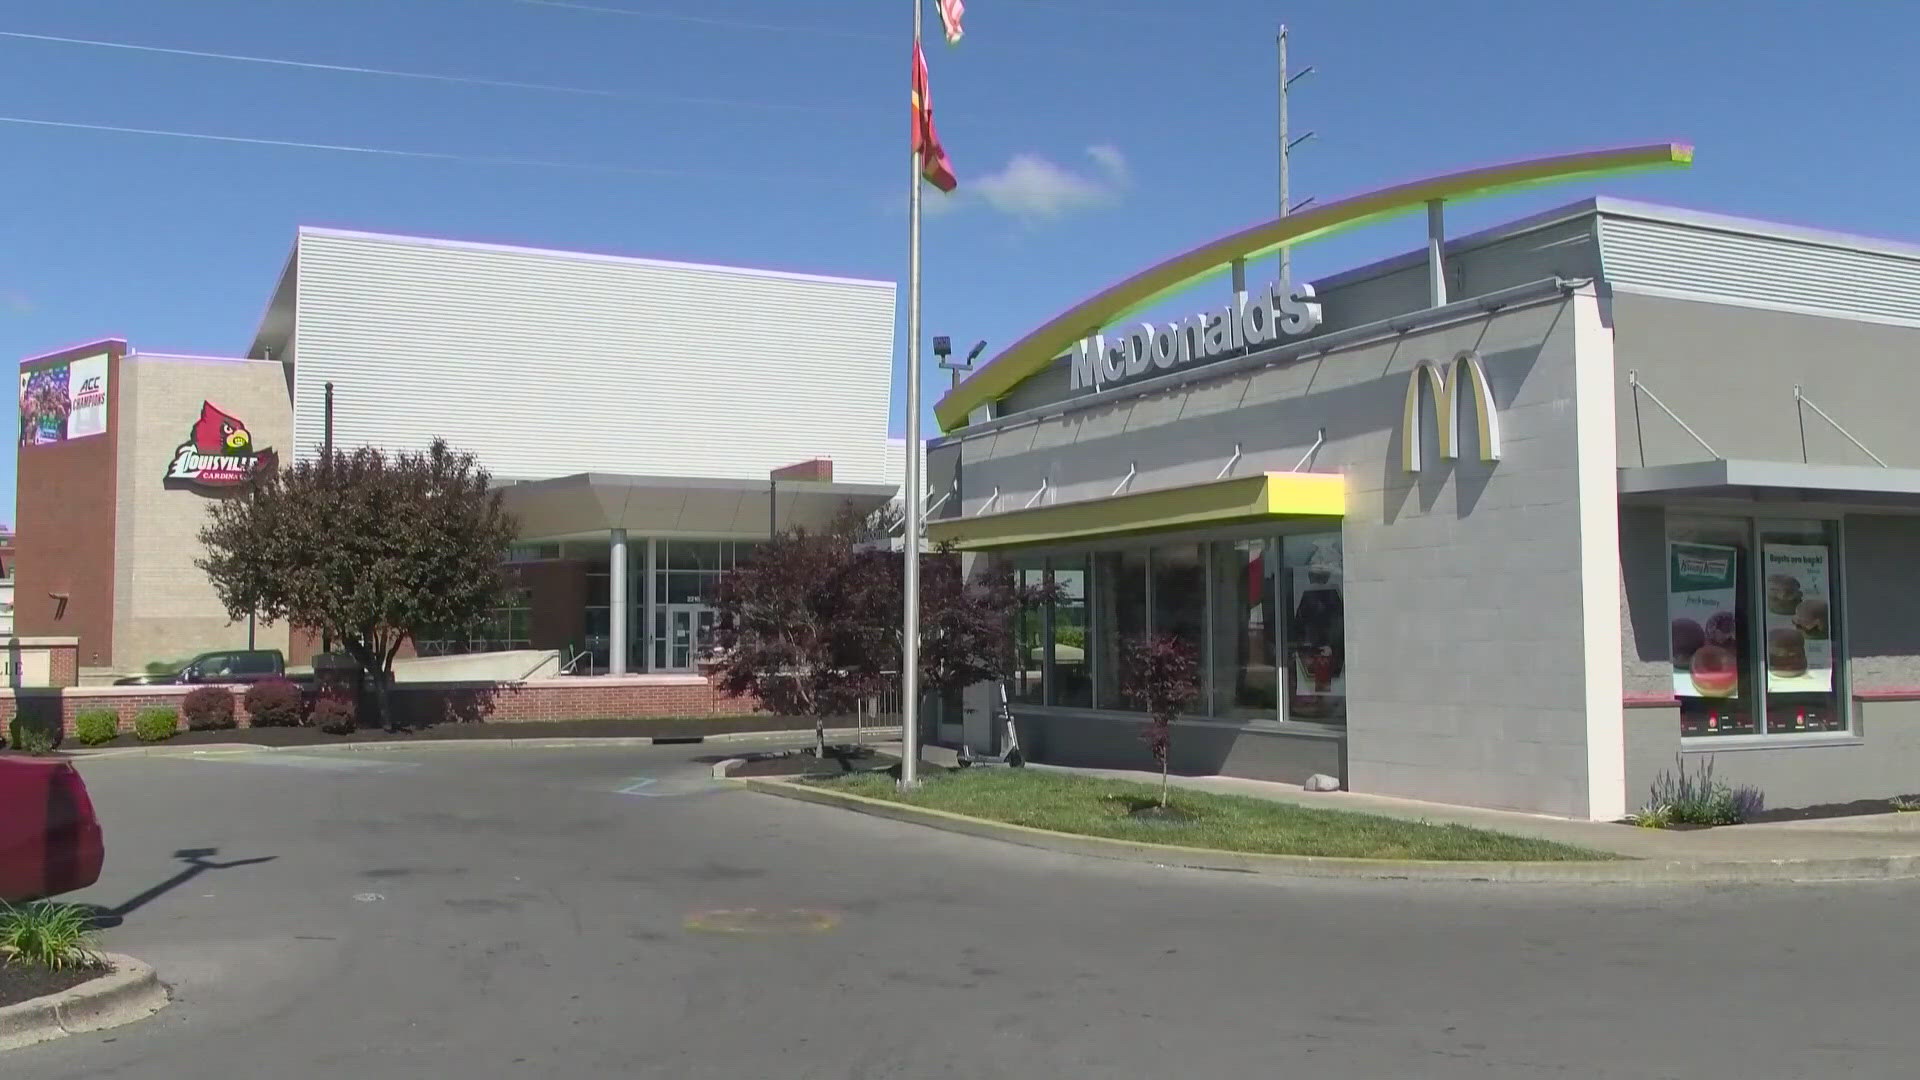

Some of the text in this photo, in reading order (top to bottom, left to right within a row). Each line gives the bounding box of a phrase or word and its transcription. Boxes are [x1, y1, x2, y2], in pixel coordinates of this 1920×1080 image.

[80, 376, 101, 392] ACC
[202, 471, 253, 481] CARDINAL
[0, 661, 23, 676] LE
